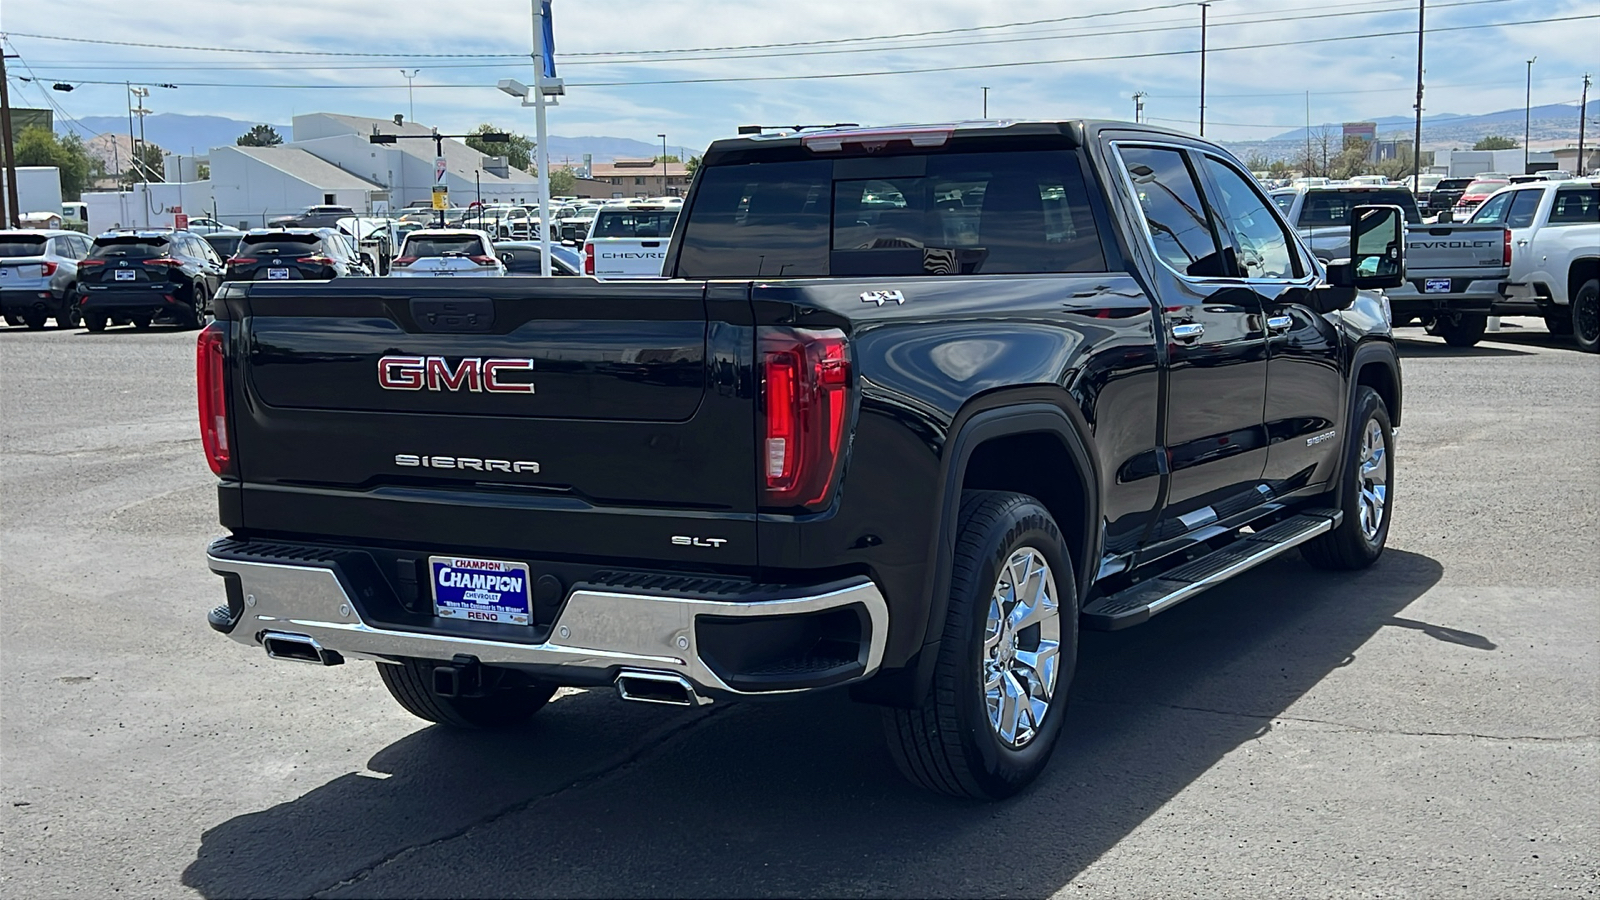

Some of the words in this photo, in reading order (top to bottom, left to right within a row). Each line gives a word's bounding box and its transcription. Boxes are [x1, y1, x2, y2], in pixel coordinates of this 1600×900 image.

[1406, 241, 1496, 249] EVROLET
[378, 355, 535, 394] GMC
[1306, 430, 1336, 447] SIERRA
[395, 453, 540, 474] SIERRA
[671, 535, 728, 549] SLT
[995, 513, 1058, 563] WRANGLER
[455, 559, 501, 570] CHAMPION
[465, 592, 499, 601] CHEVROLET
[467, 611, 498, 621] RENO
